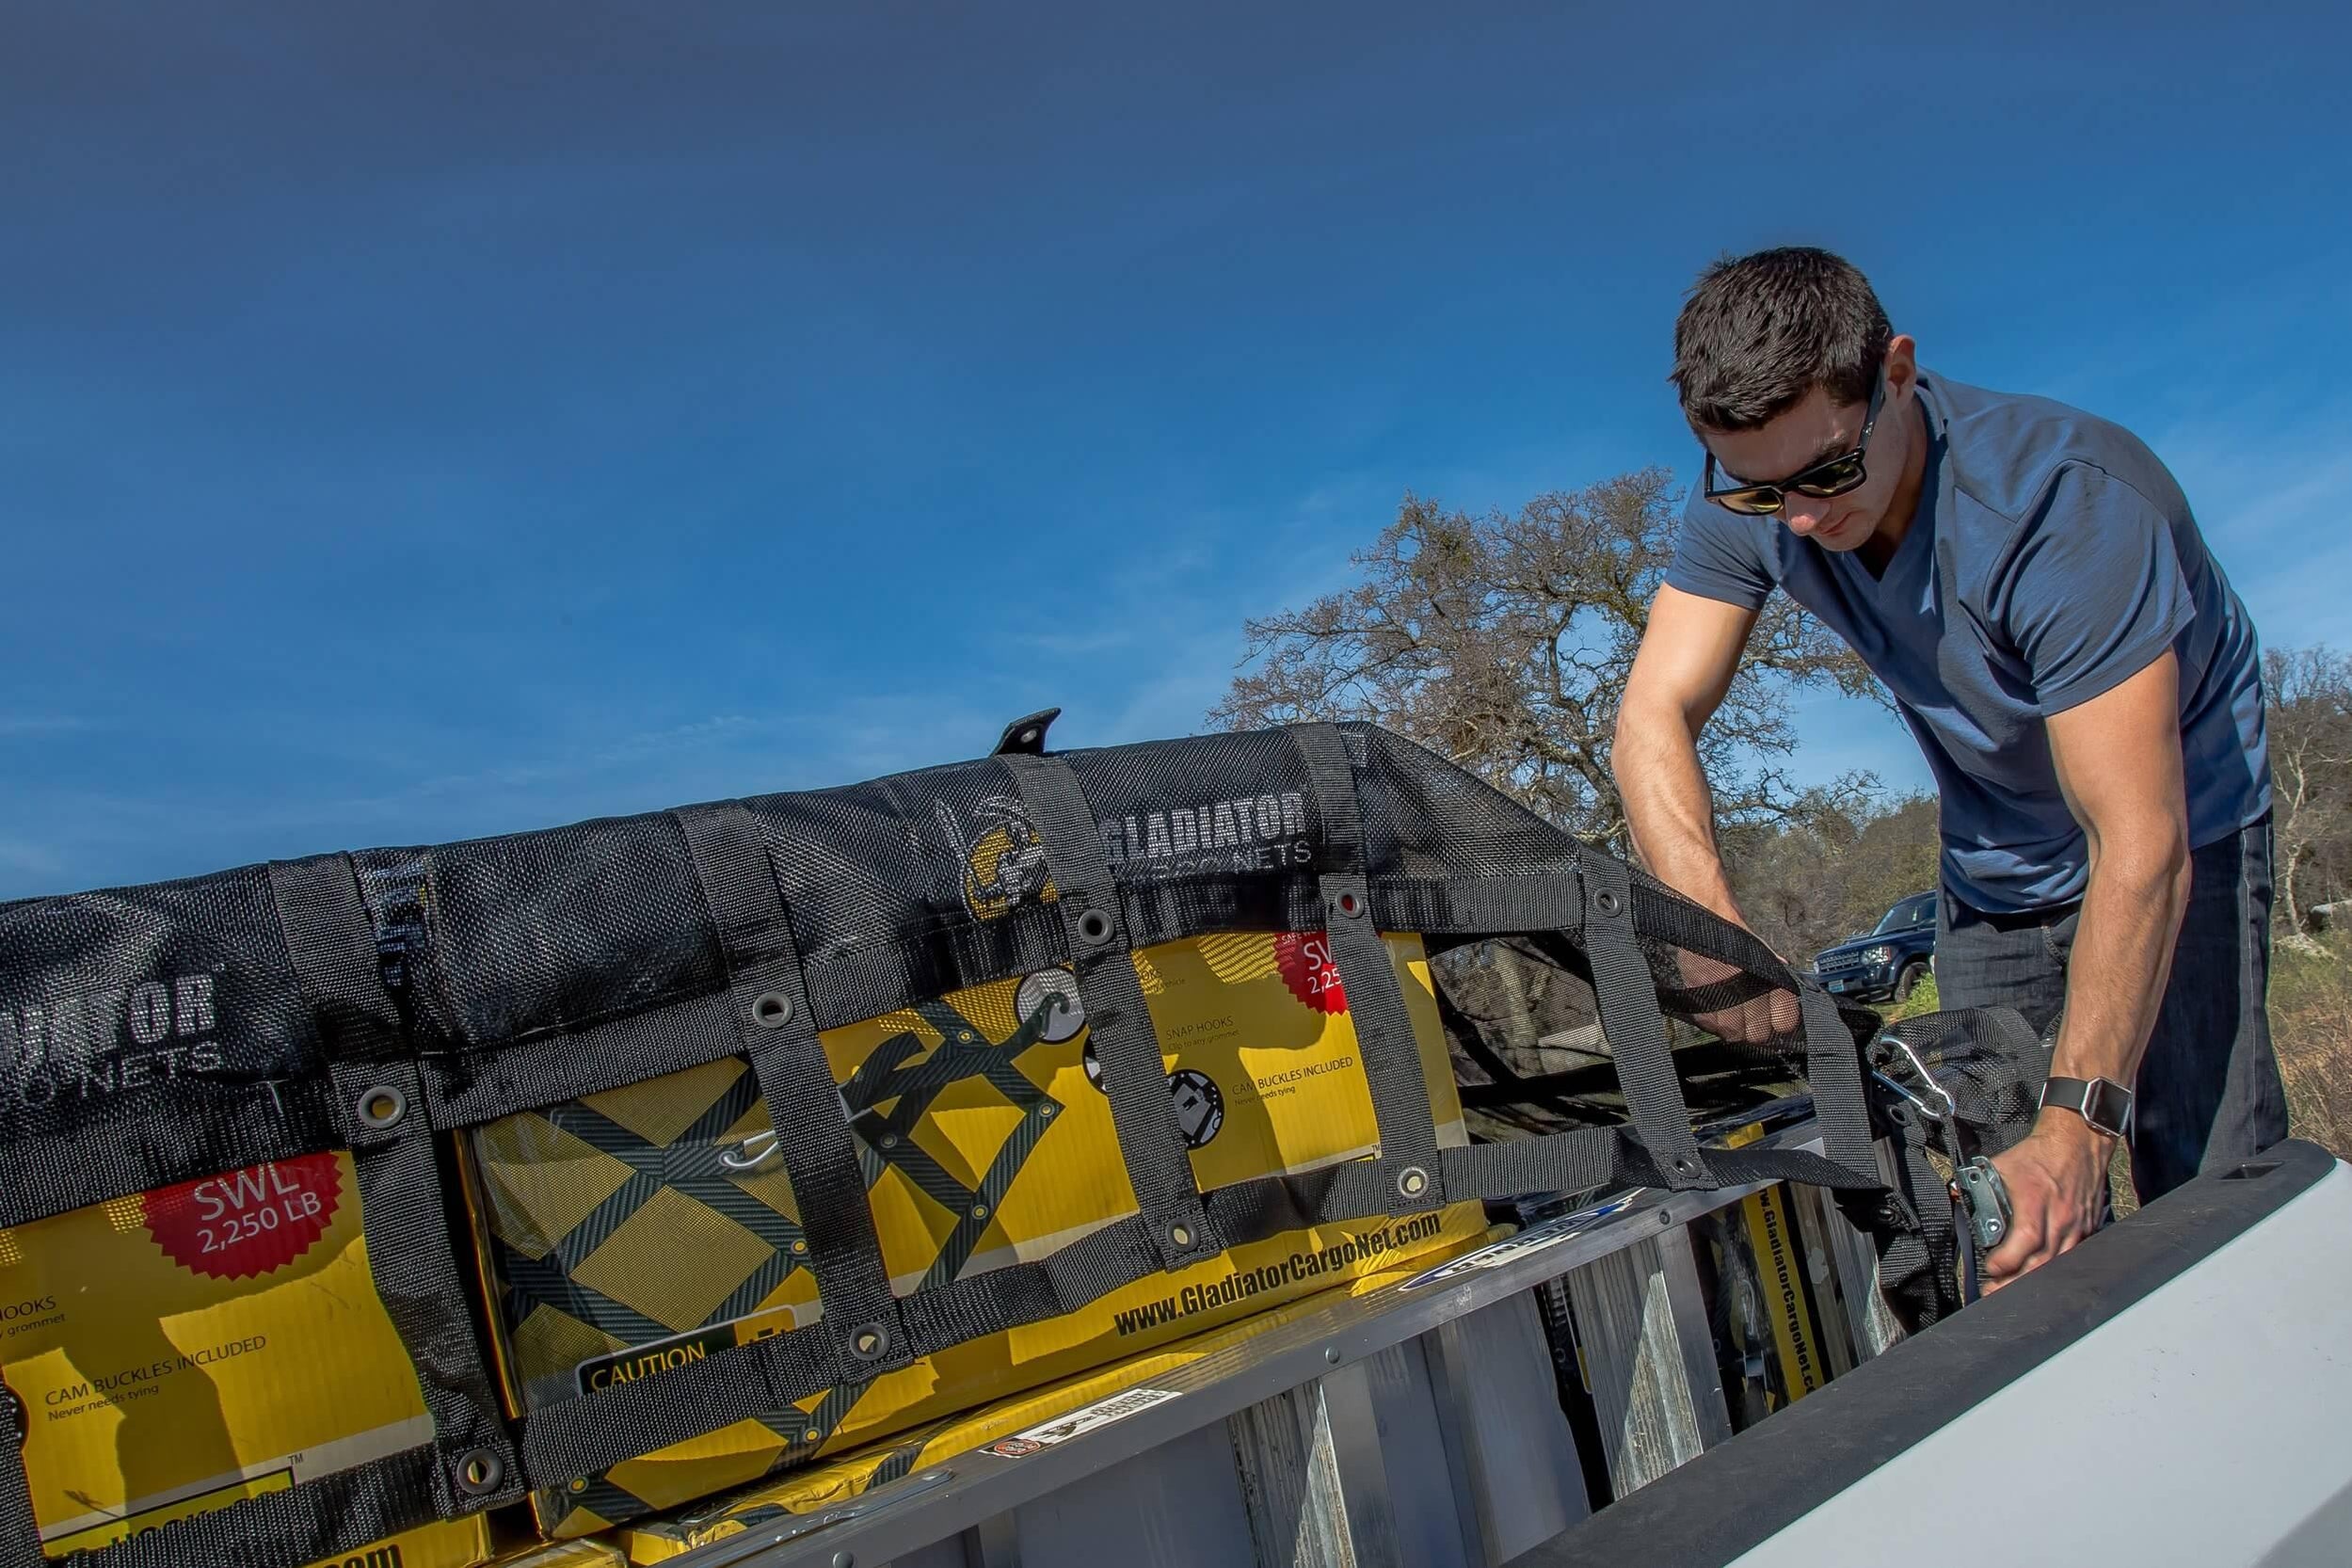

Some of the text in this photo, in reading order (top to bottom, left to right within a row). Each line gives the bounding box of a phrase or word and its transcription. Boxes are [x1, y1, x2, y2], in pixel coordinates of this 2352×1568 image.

[1098, 792, 1306, 865] GLADIATOR
[1166, 1016, 1234, 1041] SNAP HOOKS
[79, 1042, 221, 1099] NETS
[1232, 1056, 1354, 1096] CAM BUCKLES INCLUDED
[1277, 1085, 1297, 1096] tying
[193, 1161, 301, 1222] SWL
[196, 1191, 322, 1255] 2,250 LB
[1112, 1212, 1443, 1337] www.GladiatorCargoNet.com
[8, 1313, 66, 1339] grommet
[45, 1335, 267, 1406] CAM BUCKLES INCLUDED
[590, 1340, 706, 1392] CAUTION
[48, 1384, 160, 1422] Never needs tying
[287, 1452, 305, 1466] TM
